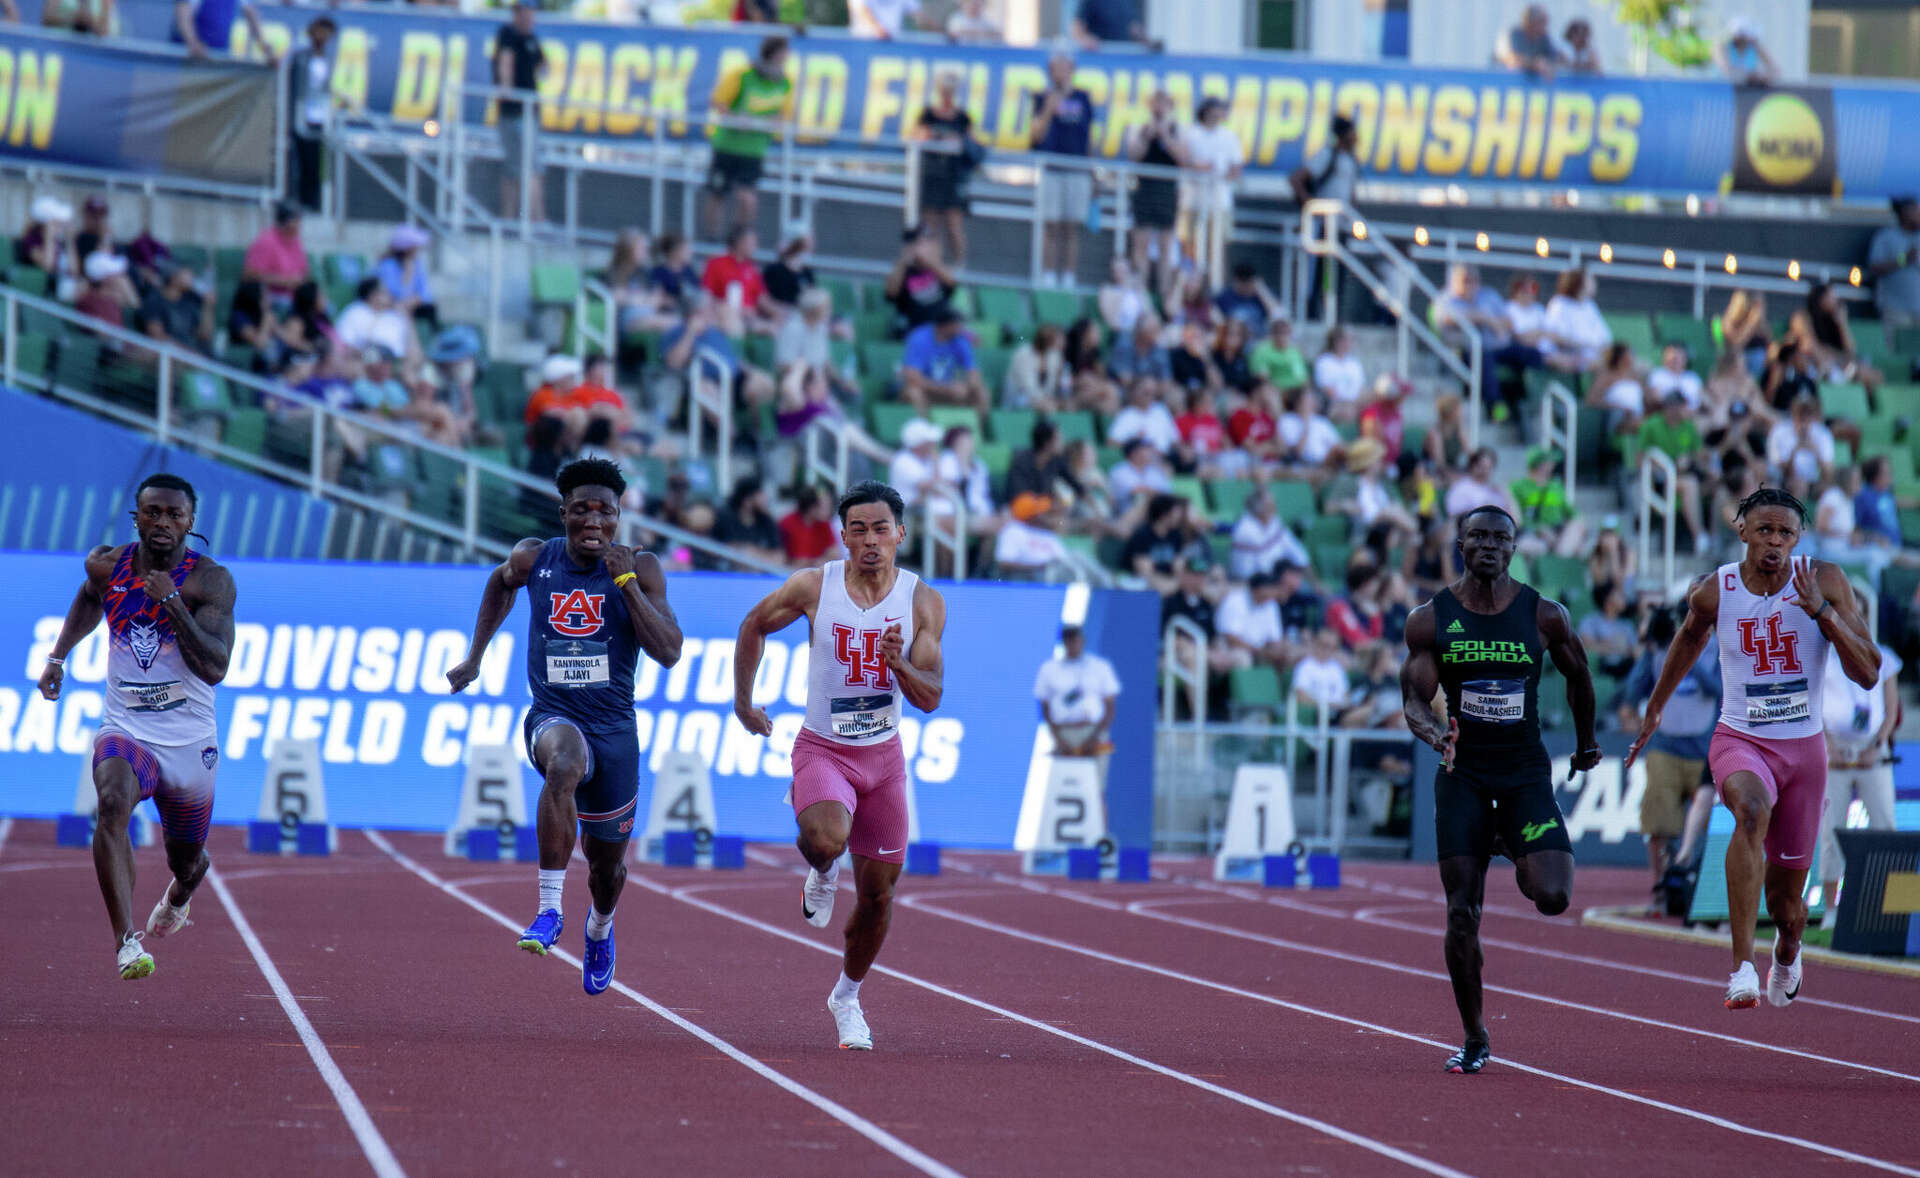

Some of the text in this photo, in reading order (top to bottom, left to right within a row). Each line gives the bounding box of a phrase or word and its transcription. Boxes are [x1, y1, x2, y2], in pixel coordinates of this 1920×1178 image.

[483, 36, 698, 138] RACK
[862, 56, 1048, 153] FILD
[1725, 573, 1736, 591] C
[553, 658, 600, 668] KANYINSOLA
[832, 623, 893, 690] UH
[1442, 651, 1534, 664] FLORIDA
[1449, 640, 1526, 652] SOUTH
[1737, 611, 1803, 676] UH
[564, 670, 590, 680] AJAYI
[226, 696, 406, 764] FIELD
[853, 712, 874, 722] LOUIE
[477, 778, 508, 824] 5
[665, 784, 702, 830] 4
[1054, 796, 1085, 843] 2
[1256, 803, 1266, 853] 1
